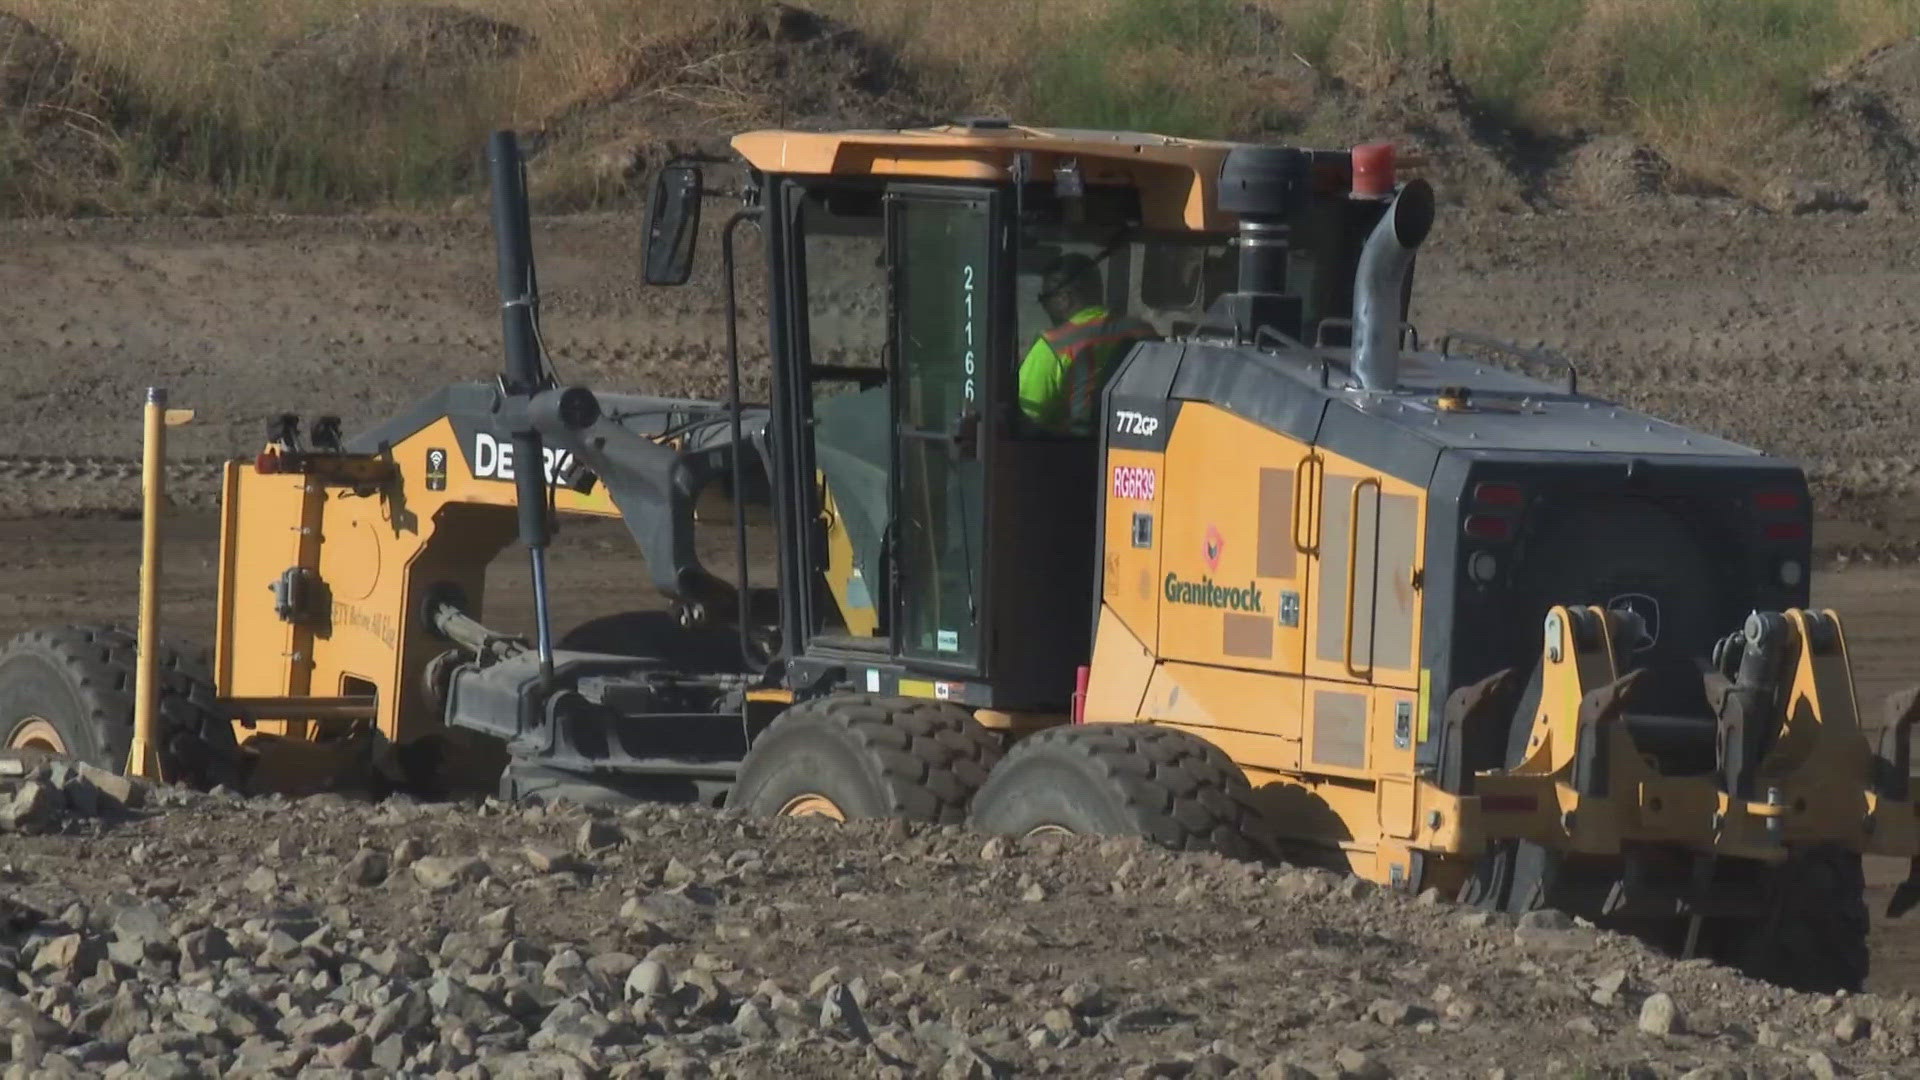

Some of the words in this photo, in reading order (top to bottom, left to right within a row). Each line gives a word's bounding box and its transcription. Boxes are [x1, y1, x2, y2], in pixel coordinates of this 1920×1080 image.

[963, 265, 975, 403] 21166
[1116, 410, 1158, 436] 772GP
[475, 433, 573, 485] DER
[1113, 466, 1155, 500] RG6R39
[1164, 571, 1262, 612] Graniterock
